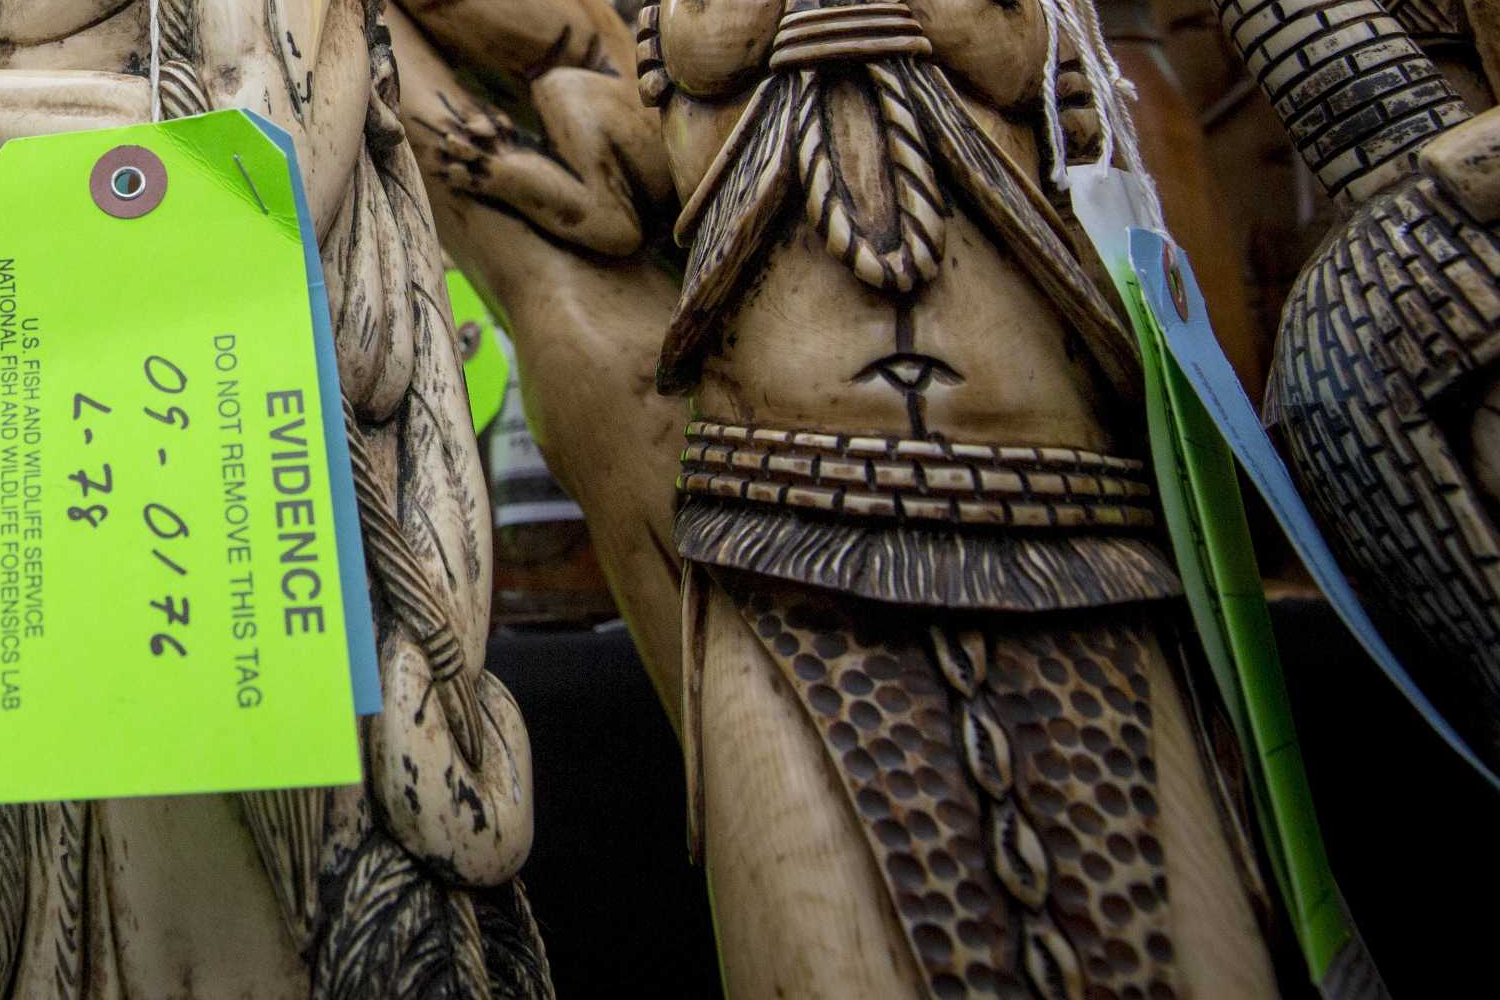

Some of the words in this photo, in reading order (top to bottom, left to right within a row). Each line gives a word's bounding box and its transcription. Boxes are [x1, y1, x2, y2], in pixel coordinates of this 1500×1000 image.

[22, 318, 39, 353] U.S.
[214, 335, 237, 371] DO
[1, 356, 18, 395] FISH
[24, 360, 40, 399] FISH
[1, 401, 18, 440] AND
[24, 406, 41, 444] AND
[217, 380, 242, 434] NOT
[1, 446, 18, 535] WILDLIFE
[24, 450, 42, 539] WILDLIFE
[222, 444, 251, 563] REMOVE
[266, 389, 325, 636] EVIDENCE
[1, 542, 20, 663] FORENSICS
[25, 547, 44, 636] SERVICE
[231, 572, 257, 640] THIS
[2, 671, 20, 710] LAB
[236, 648, 262, 708] TAG
